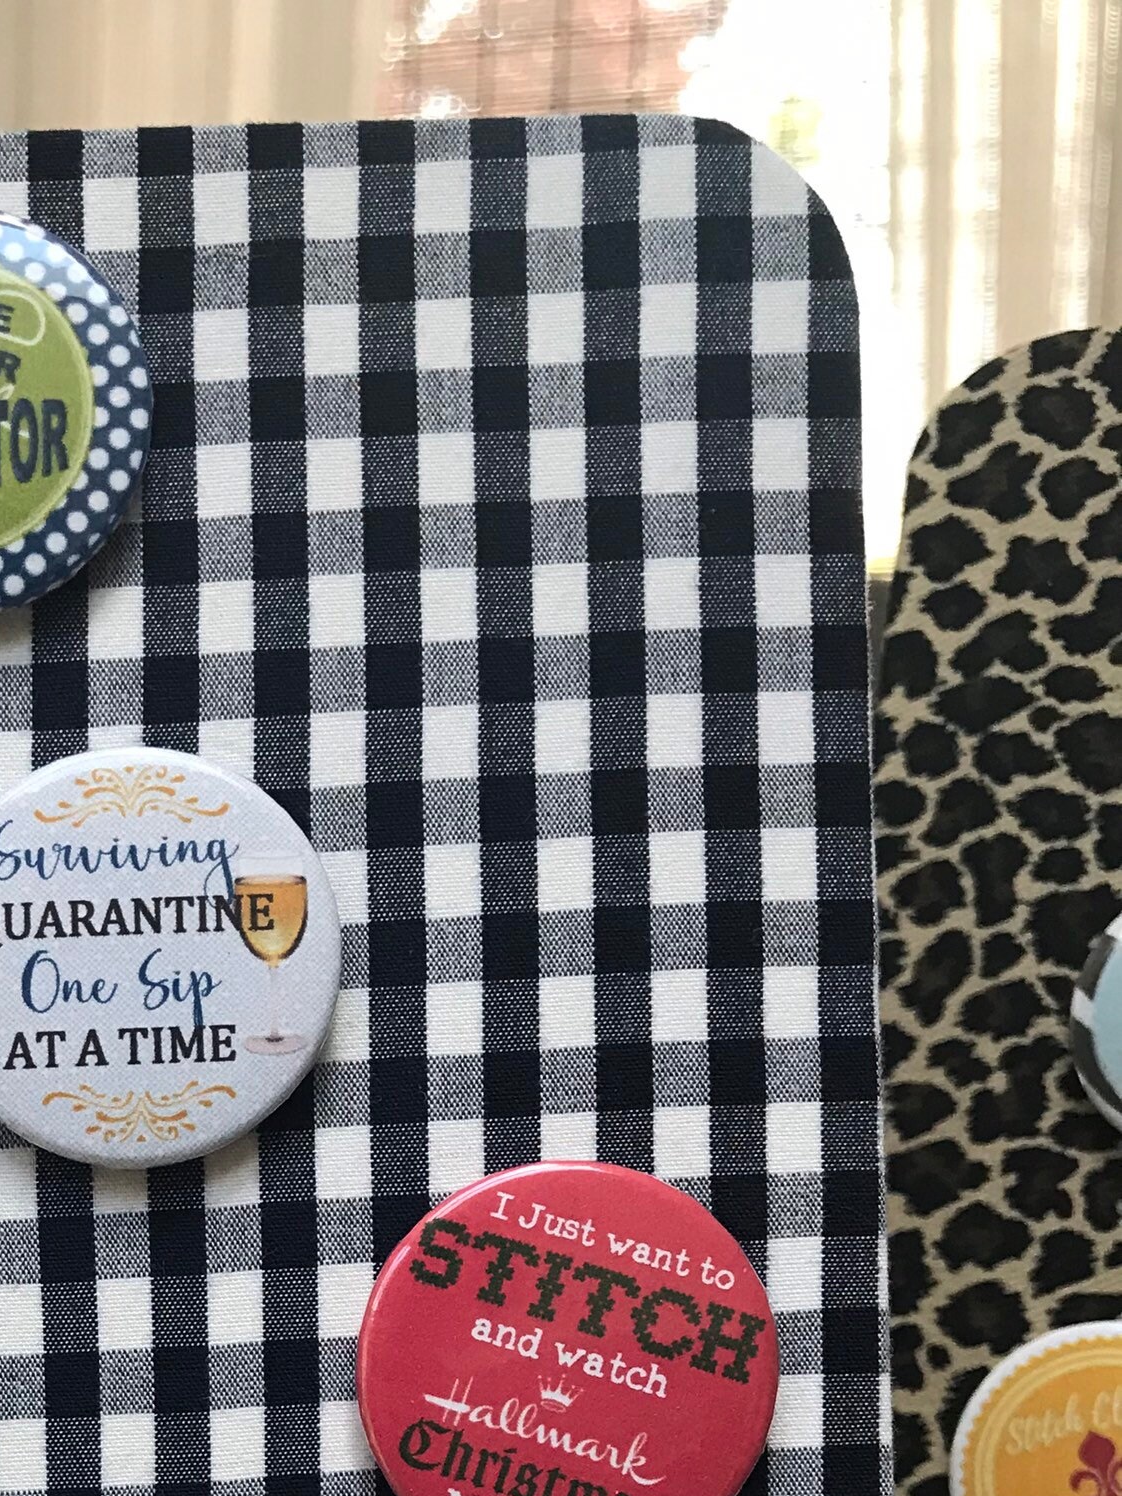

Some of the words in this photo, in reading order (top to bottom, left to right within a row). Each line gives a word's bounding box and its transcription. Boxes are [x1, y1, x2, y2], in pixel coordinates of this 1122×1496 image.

[21, 950, 118, 1013] One
[138, 948, 222, 1029] Sip
[3, 1030, 66, 1069] AT
[78, 1029, 109, 1066] A
[118, 1024, 236, 1064] TIME
[490, 1191, 515, 1221] I
[518, 1202, 598, 1248] Just
[607, 1232, 691, 1279] want
[700, 1256, 735, 1291] to
[408, 1217, 767, 1385] STITCH
[471, 1317, 543, 1360] and
[554, 1339, 668, 1399] watch
[423, 1375, 667, 1486] Hallmark
